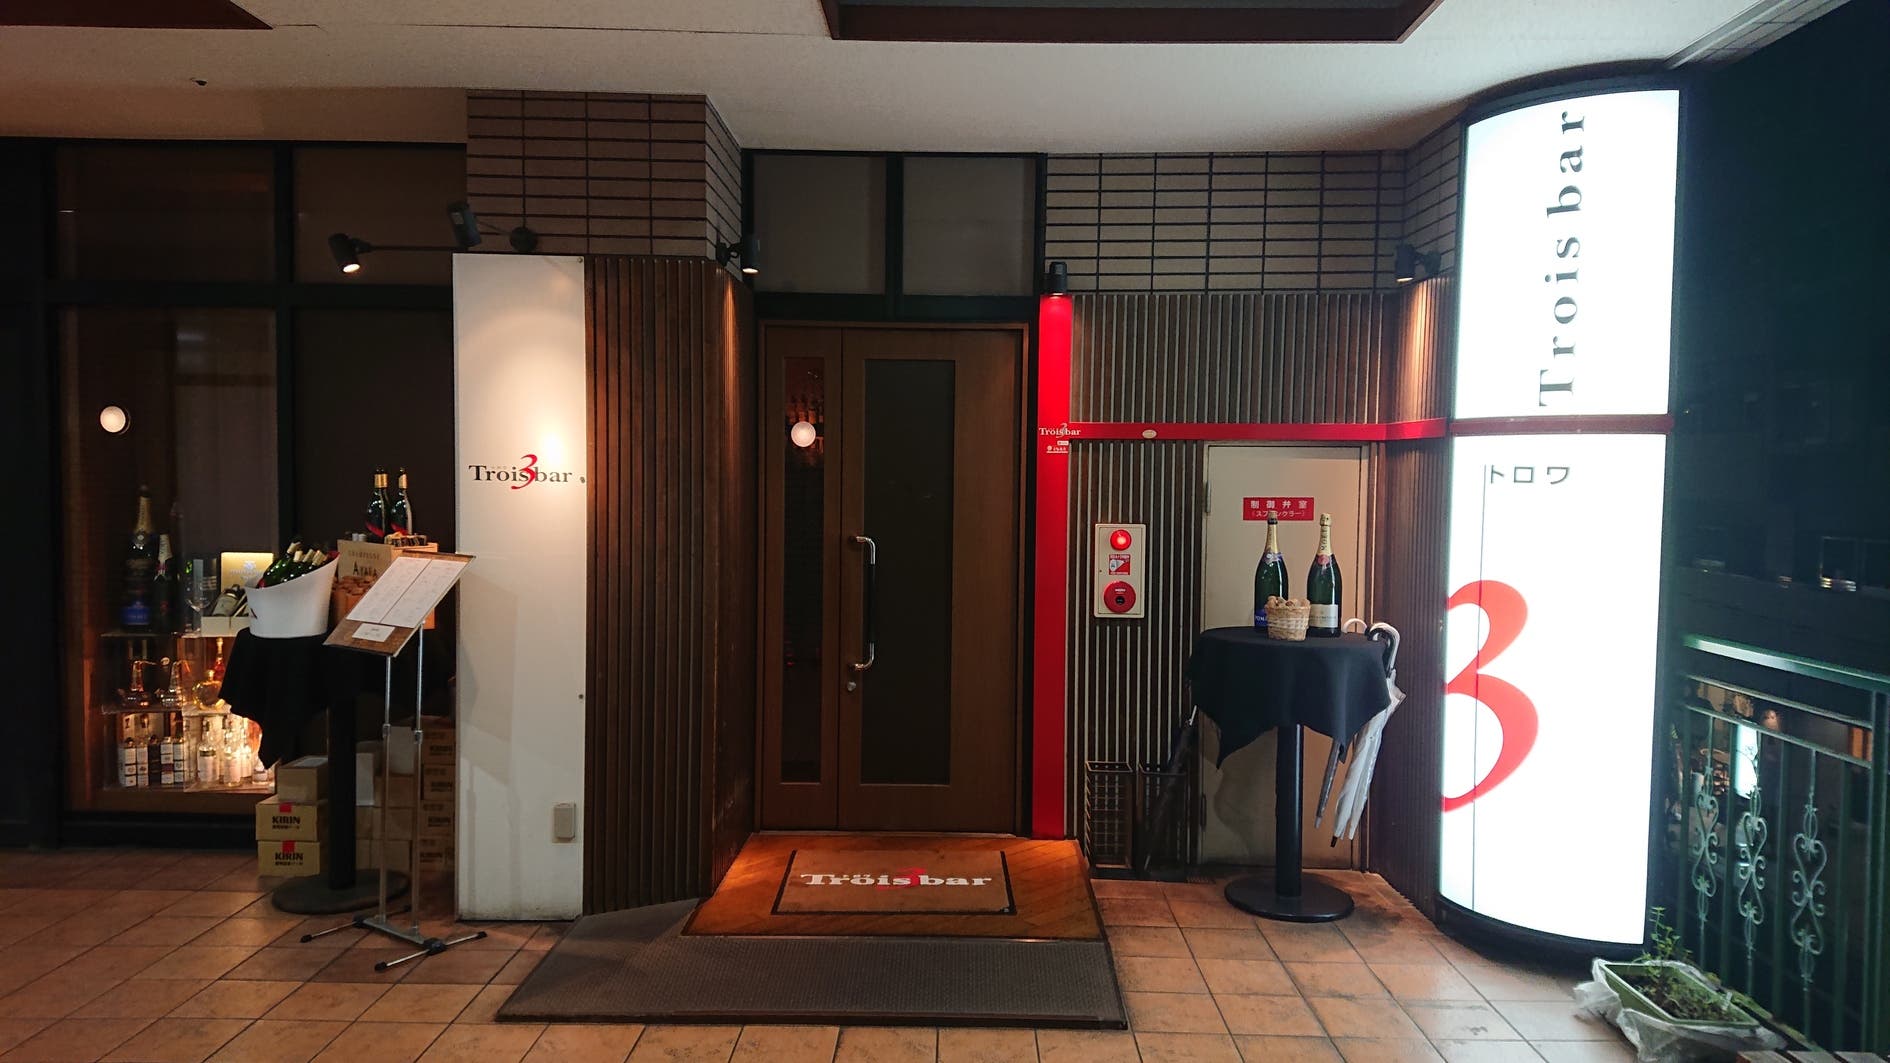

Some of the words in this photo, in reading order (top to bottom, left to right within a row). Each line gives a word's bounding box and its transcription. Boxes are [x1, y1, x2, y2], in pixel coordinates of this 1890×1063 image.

[1546, 110, 1585, 218] bar
[1538, 236, 1582, 407] Trois
[1490, 464, 1570, 485] トロワ
[272, 815, 301, 825] KIRIN
[275, 852, 304, 861] KIRIN
